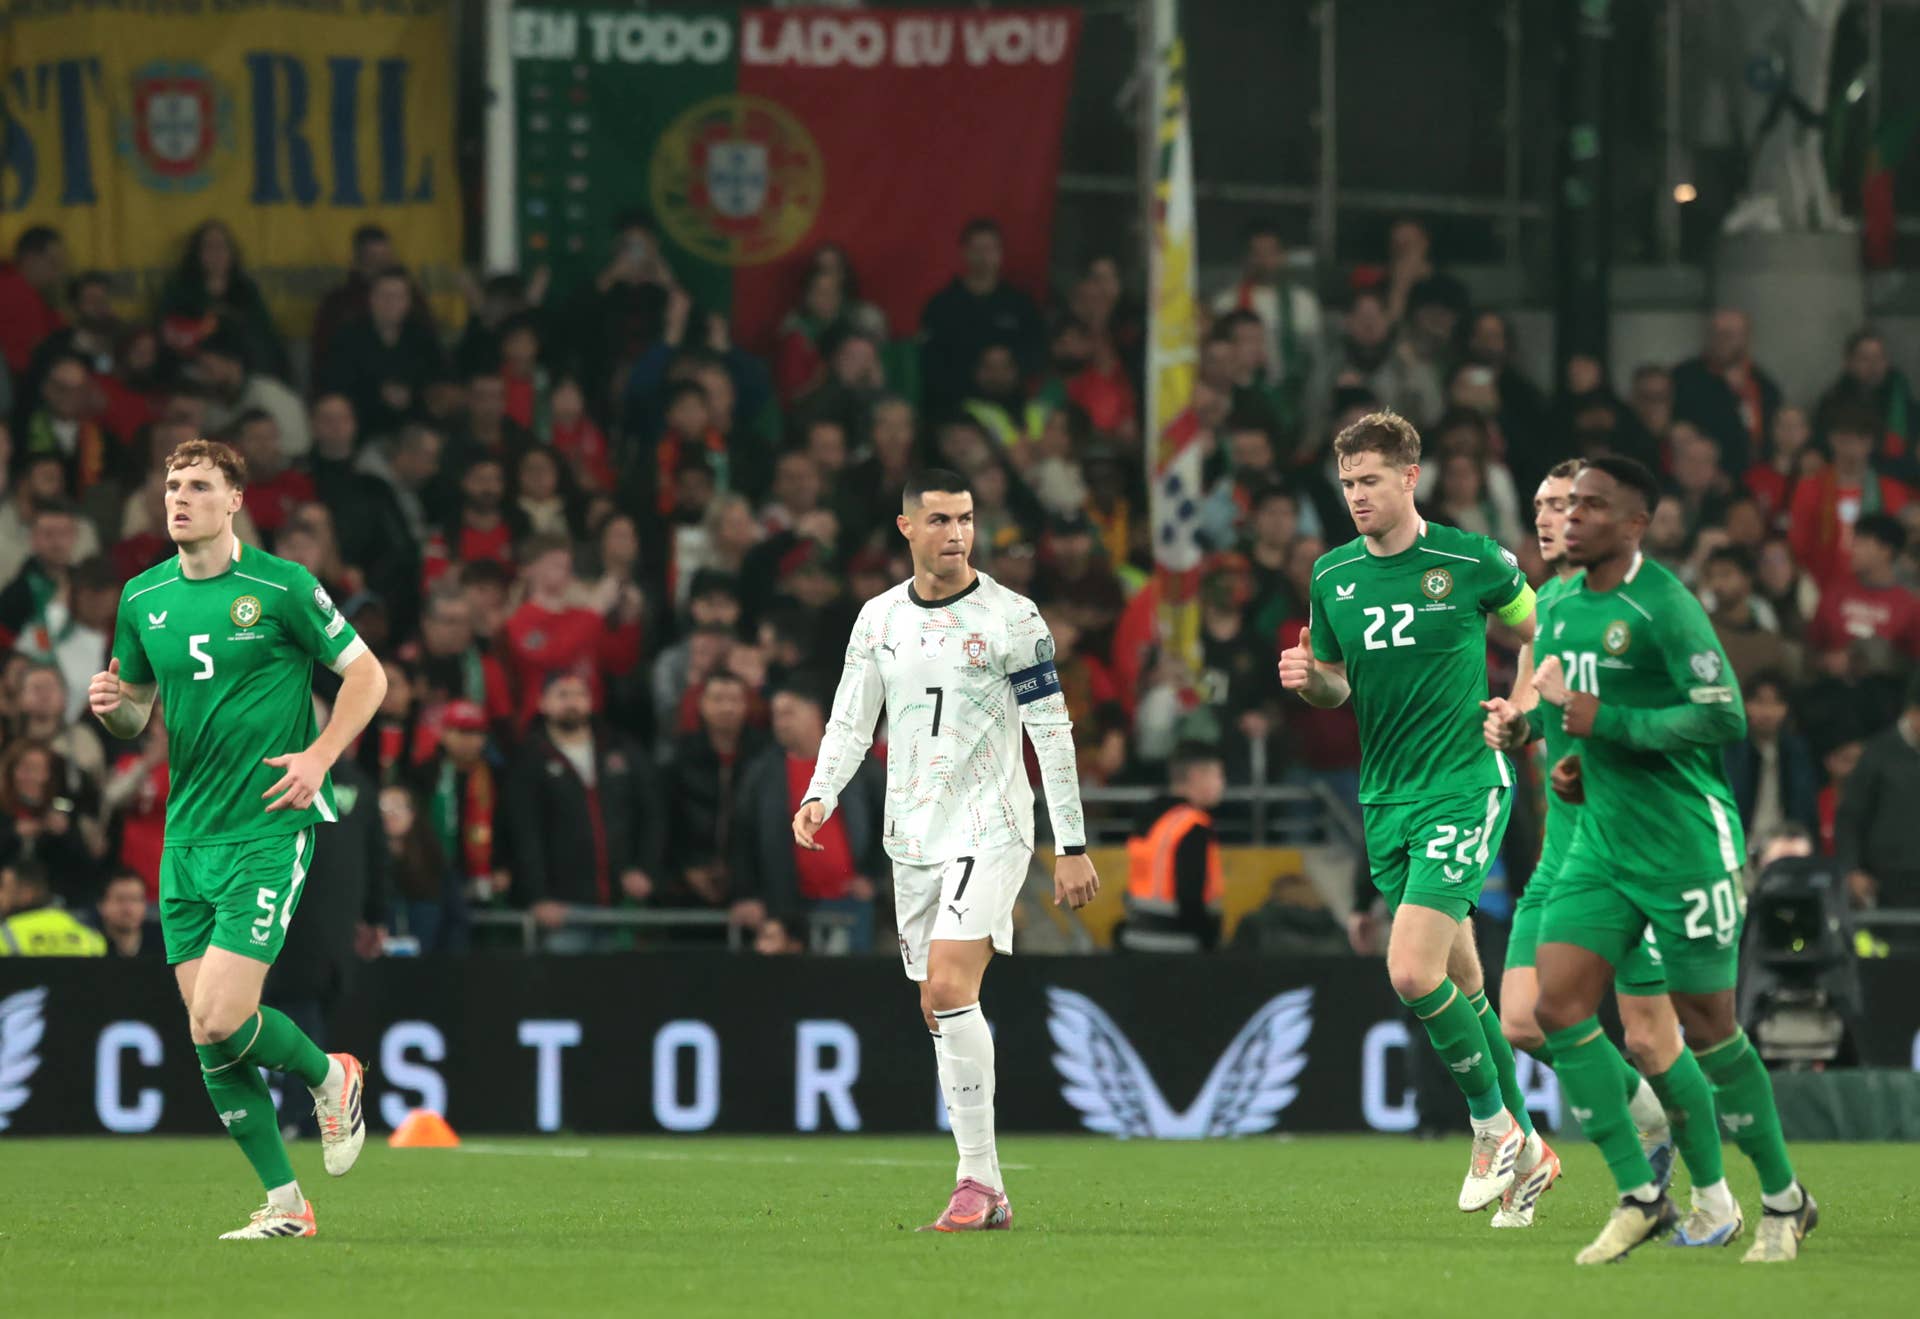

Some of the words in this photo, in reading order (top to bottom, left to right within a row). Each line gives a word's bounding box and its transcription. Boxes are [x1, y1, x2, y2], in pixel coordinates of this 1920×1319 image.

[513, 13, 577, 59] EM
[589, 14, 731, 63] TODO
[741, 17, 886, 67] LADO
[893, 19, 954, 67] EU
[963, 17, 1068, 66] VOU
[1363, 603, 1416, 651] 22
[189, 633, 214, 681] 5
[926, 687, 943, 737] 7
[1425, 824, 1483, 866] 22
[953, 856, 976, 901] 7
[254, 887, 278, 928] 5
[1681, 879, 1738, 939] 20
